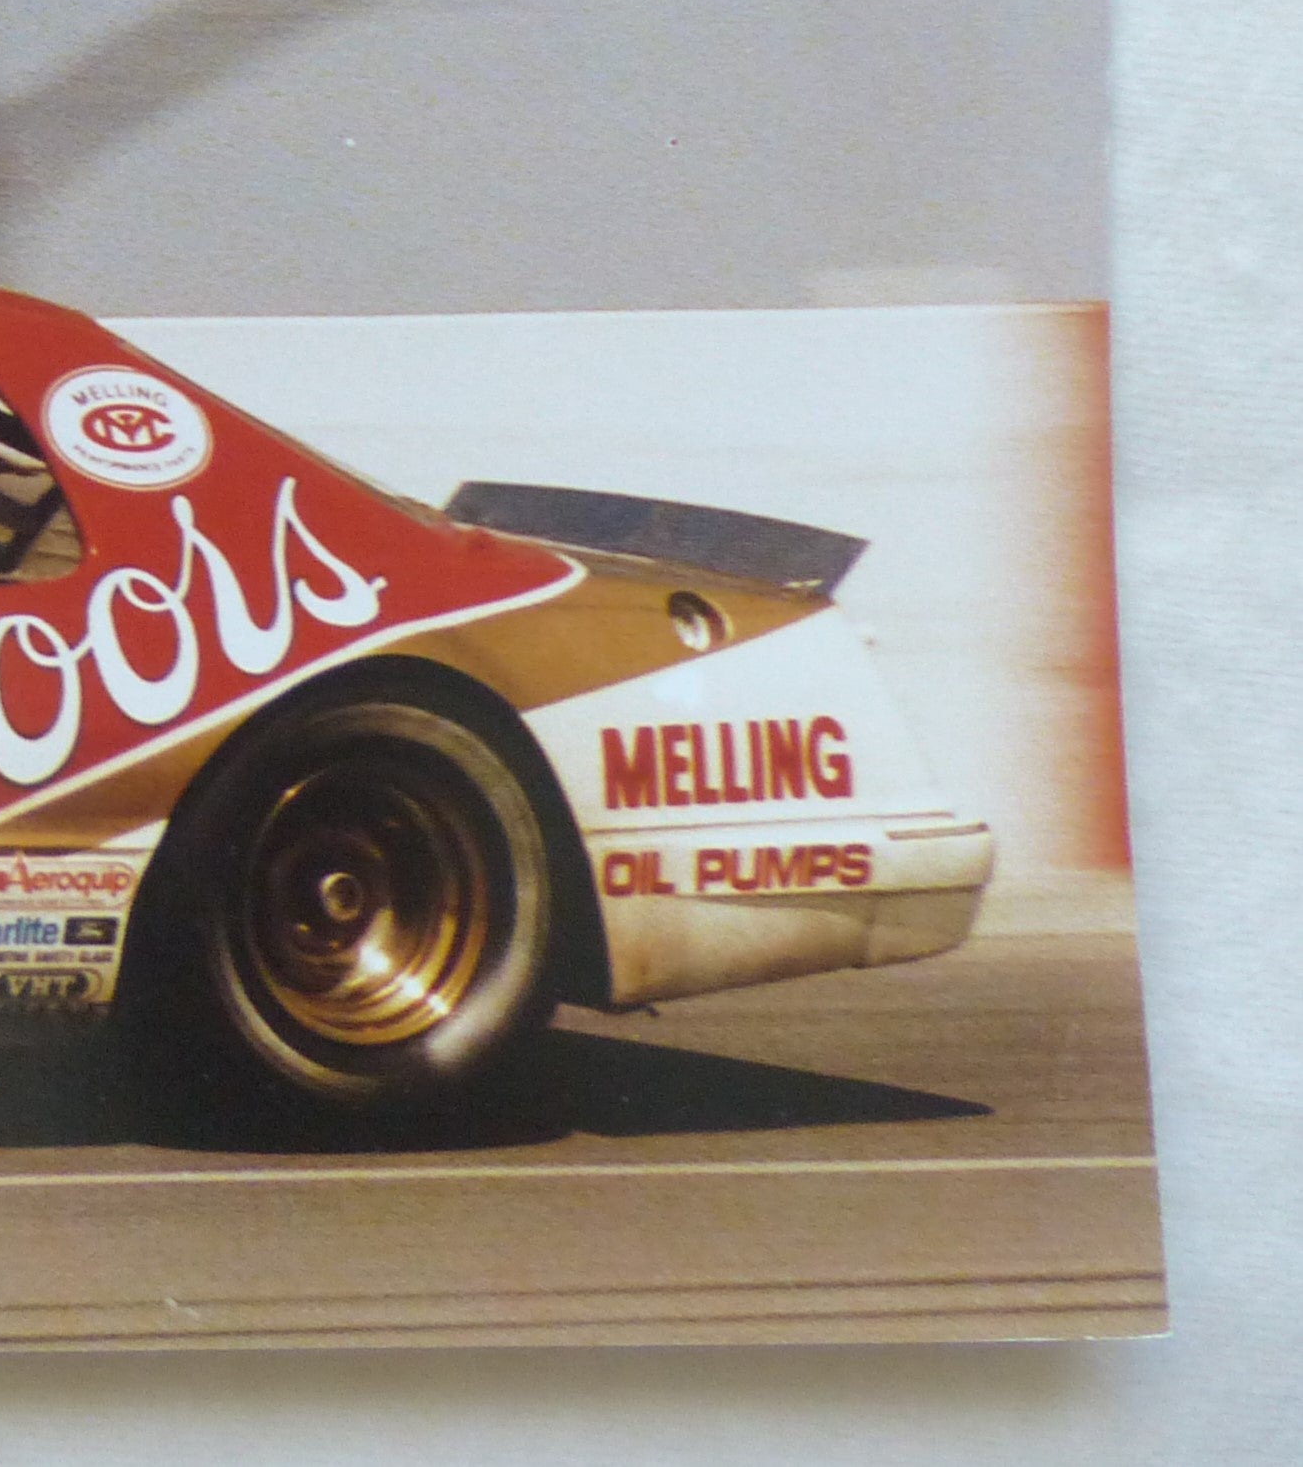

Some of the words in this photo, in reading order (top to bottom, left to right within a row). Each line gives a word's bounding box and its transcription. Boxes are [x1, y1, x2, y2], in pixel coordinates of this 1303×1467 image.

[71, 383, 168, 408] MELLING
[599, 715, 855, 811] MELLING
[7, 852, 132, 898] Aeroquip
[603, 851, 676, 897] OIL
[696, 844, 873, 891] PUMPS
[7, 974, 80, 1002] VHT
